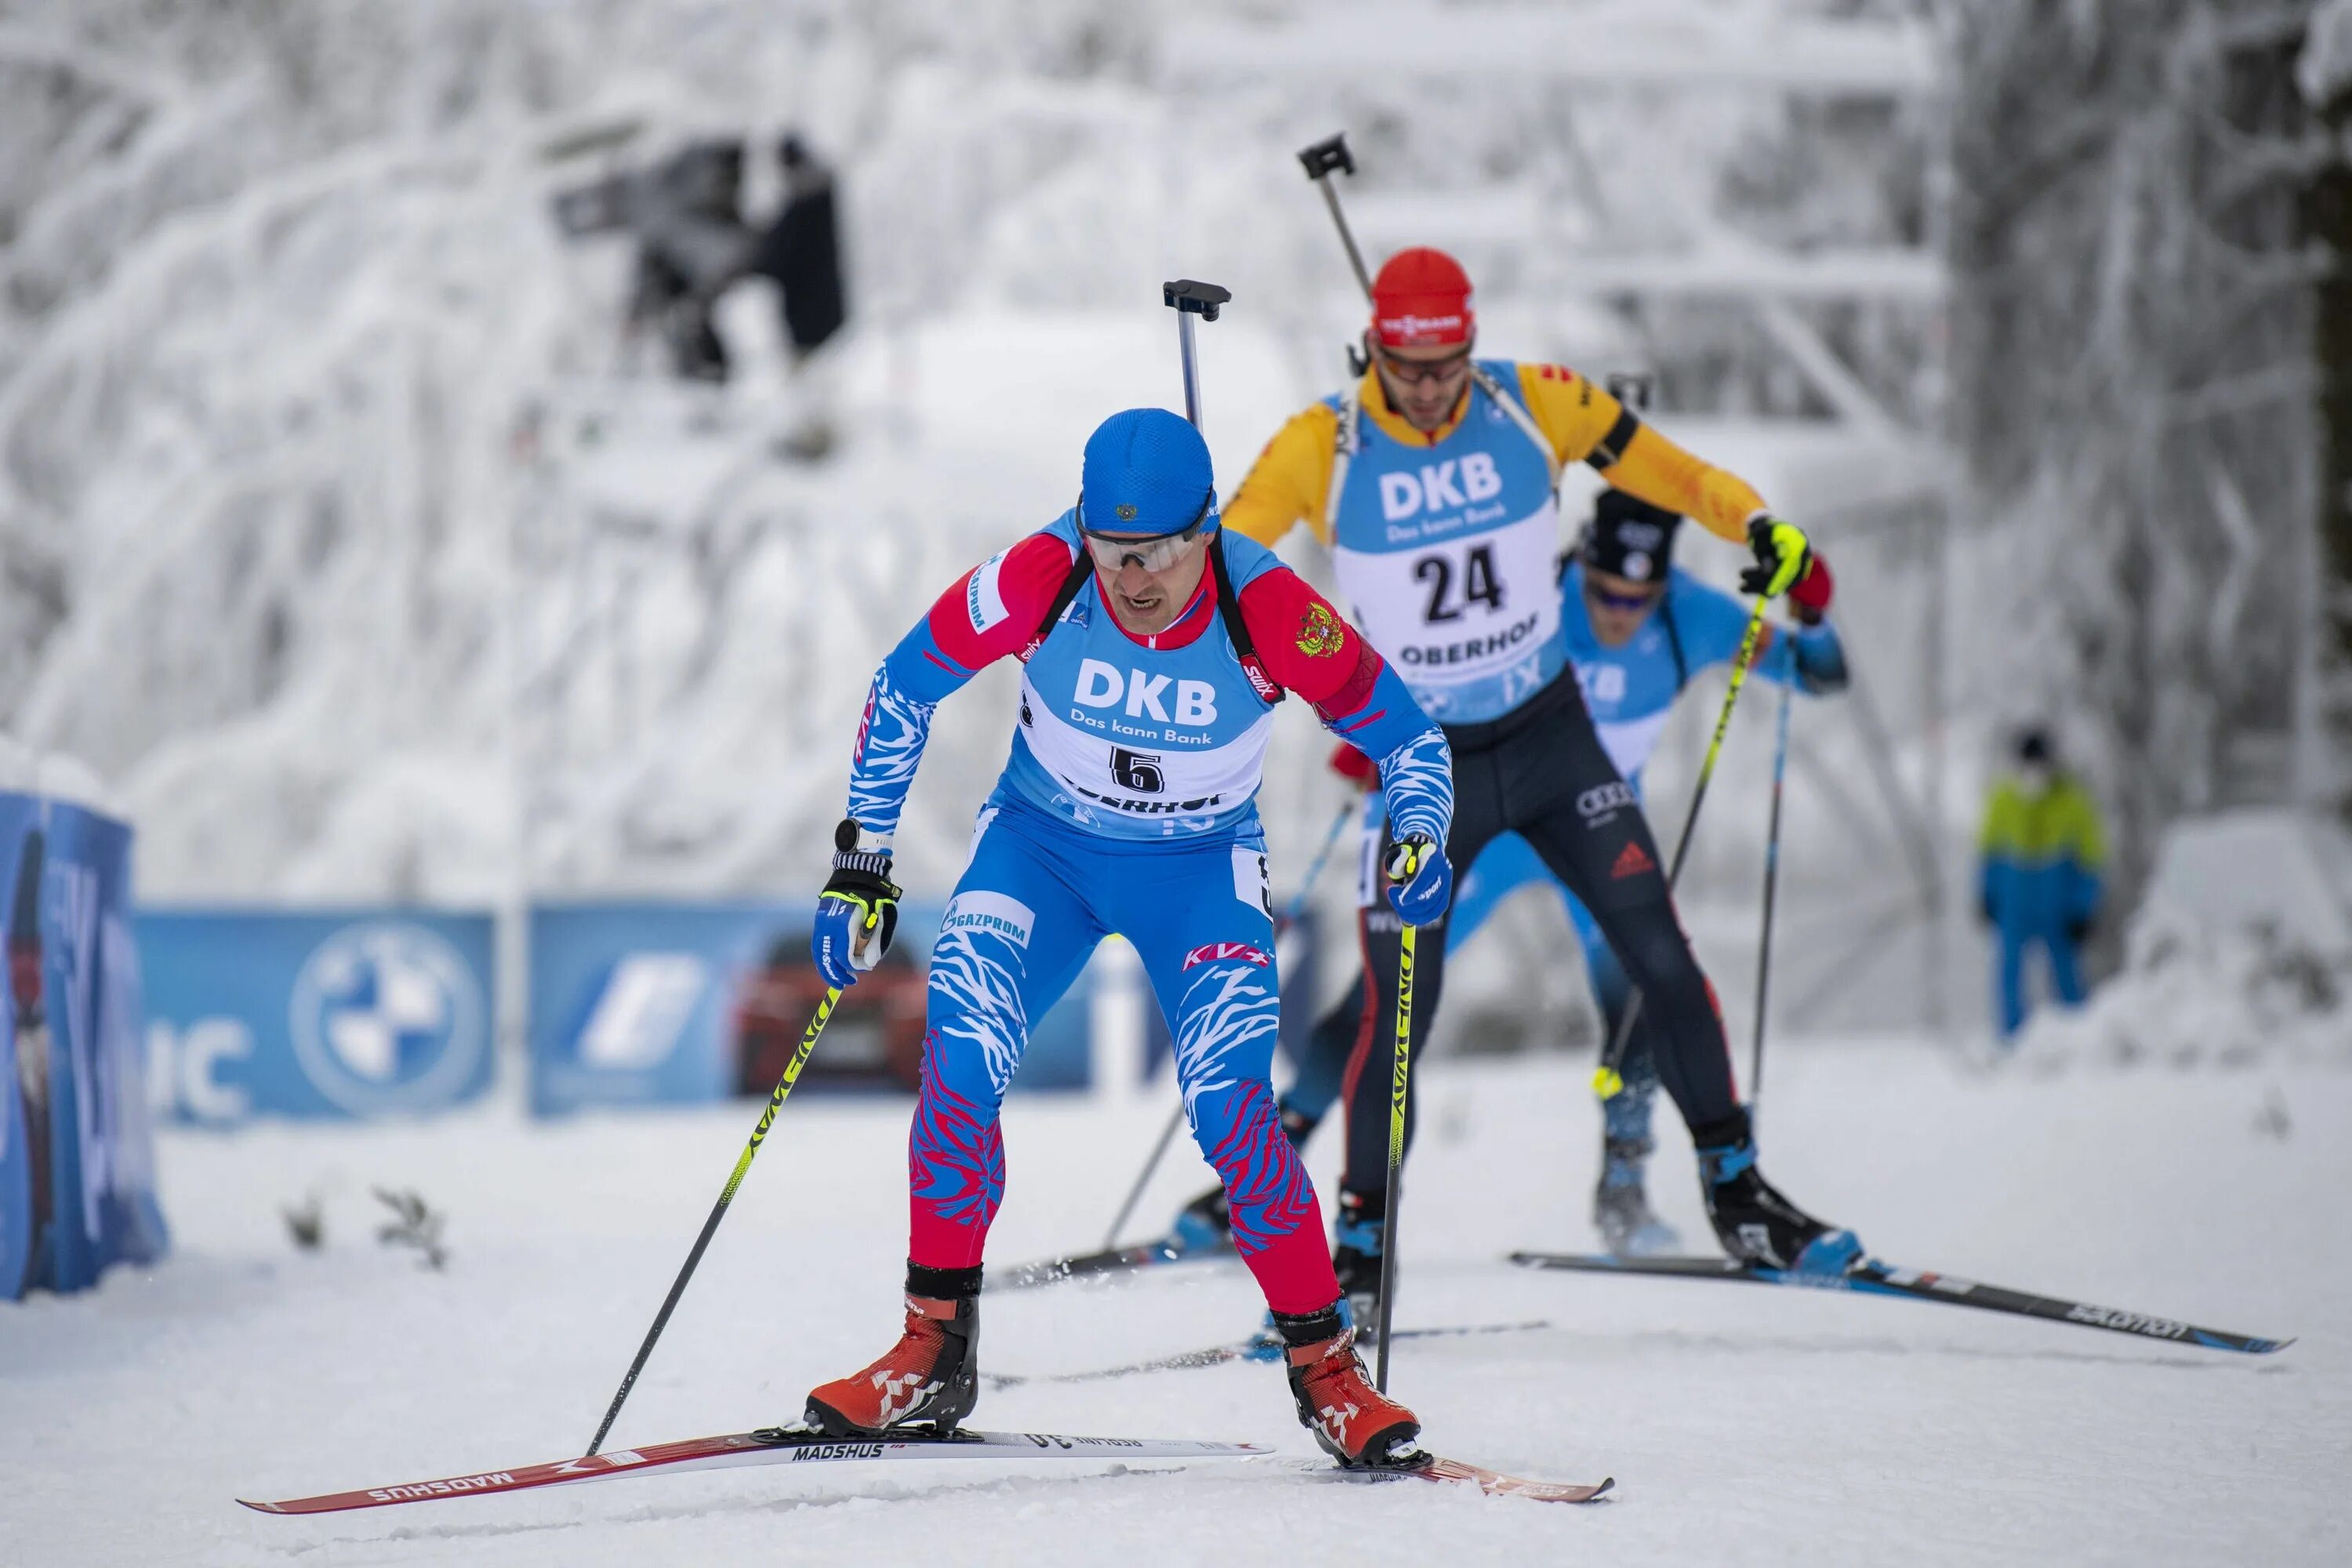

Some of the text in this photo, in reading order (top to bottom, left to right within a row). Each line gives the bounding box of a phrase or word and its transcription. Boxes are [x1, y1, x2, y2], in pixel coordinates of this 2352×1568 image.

[1380, 452, 1503, 521] DKB
[1414, 542, 1506, 626] 24
[1073, 658, 1218, 727] DKB
[1070, 708, 1212, 745] Das kann Bank
[956, 913, 1025, 942] GAZPROM
[792, 1443, 884, 1461] MADSHUS
[367, 1472, 514, 1502] MADSHUS
